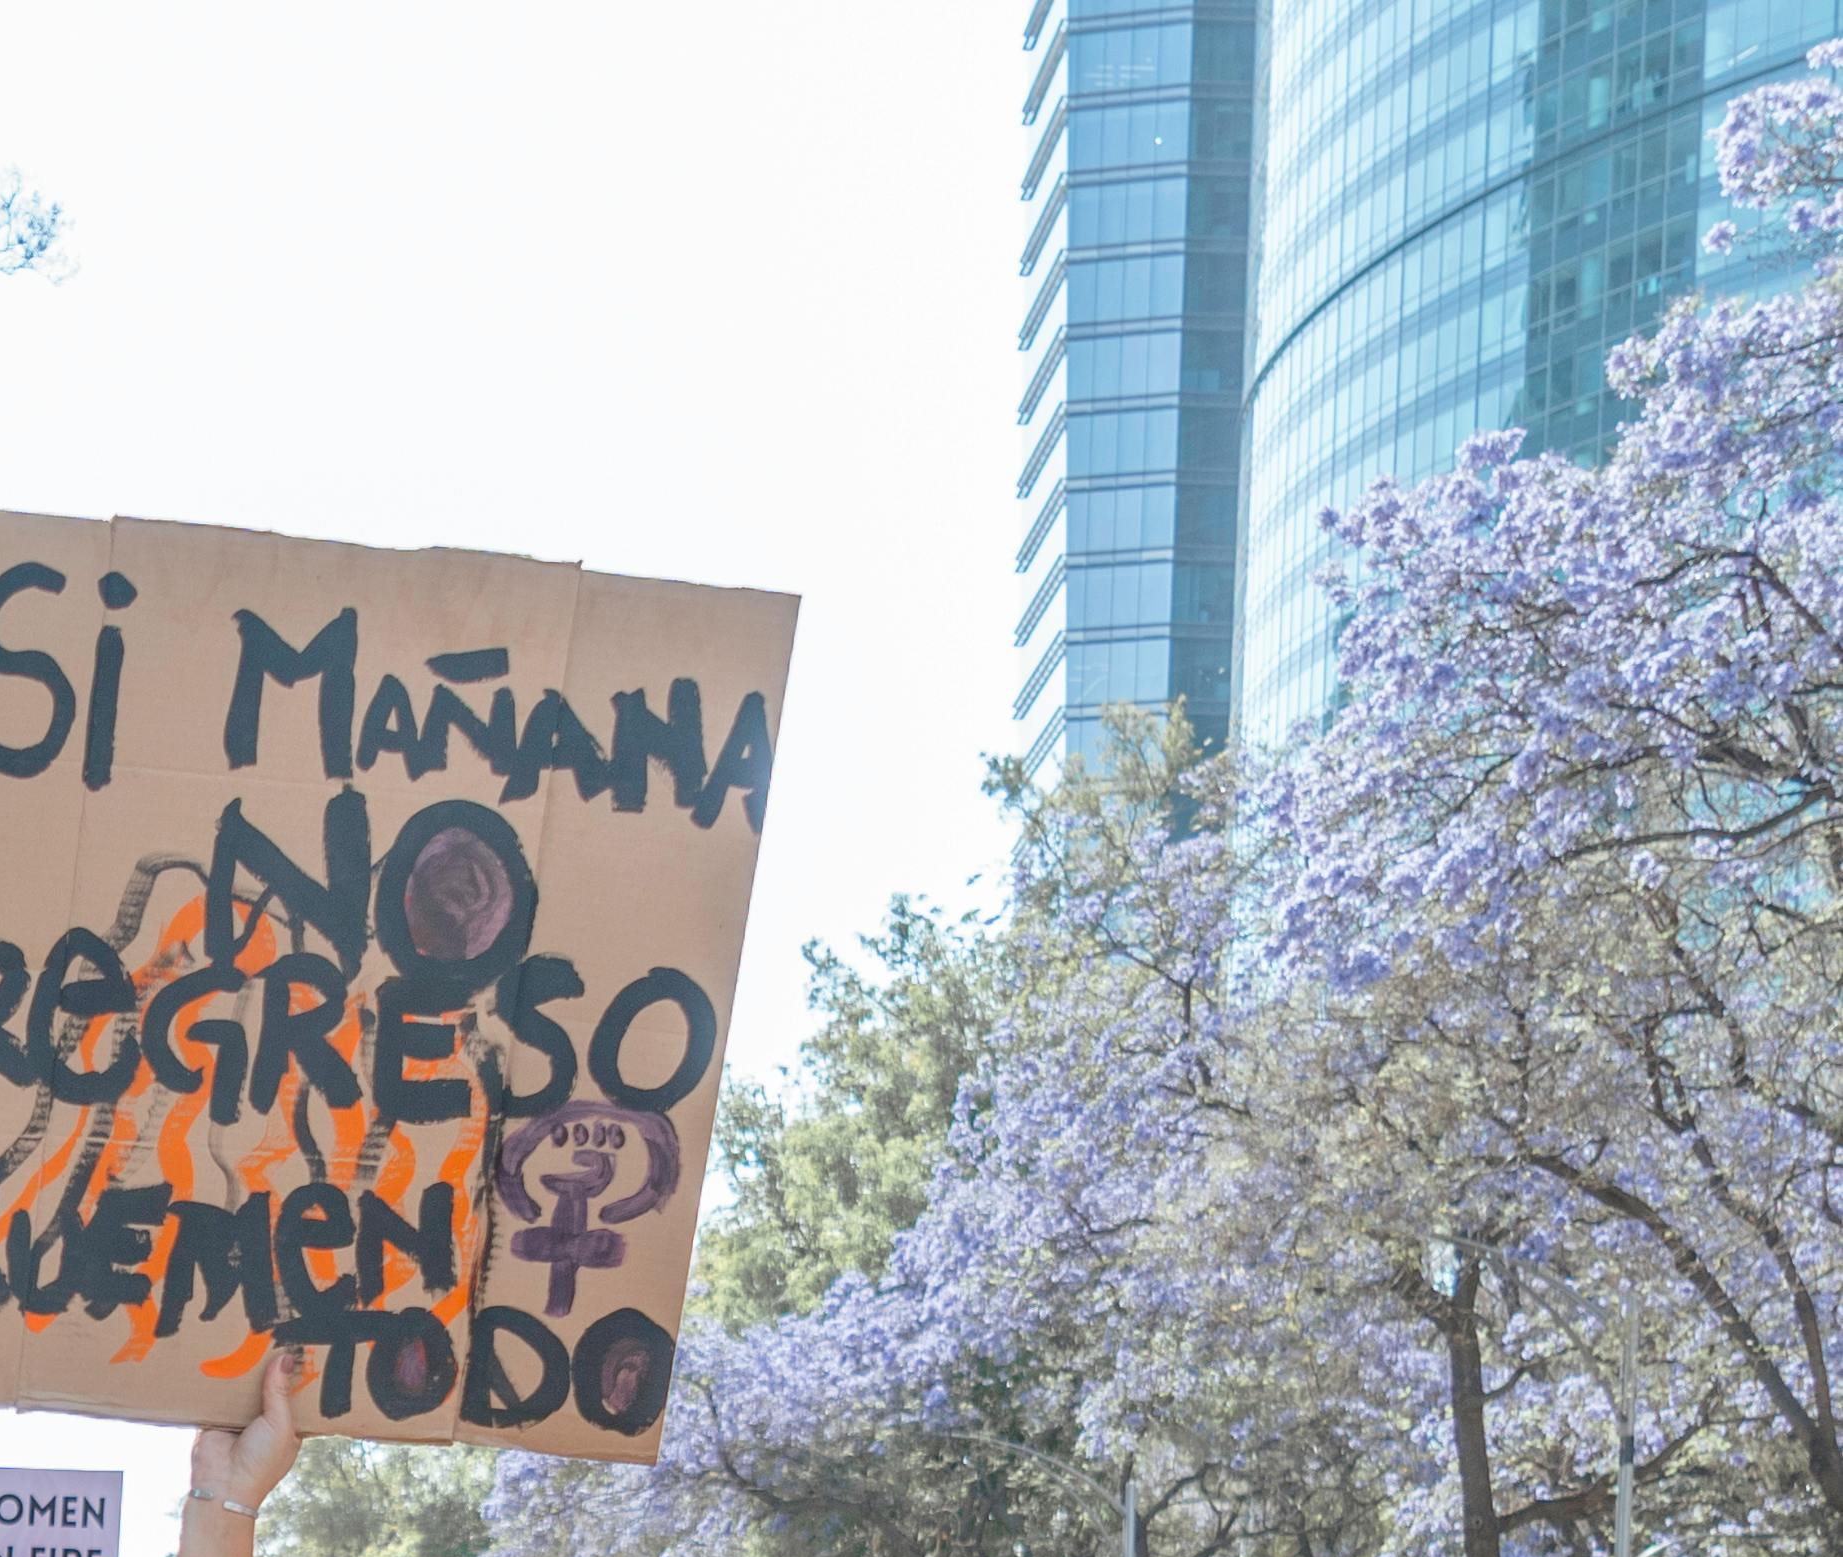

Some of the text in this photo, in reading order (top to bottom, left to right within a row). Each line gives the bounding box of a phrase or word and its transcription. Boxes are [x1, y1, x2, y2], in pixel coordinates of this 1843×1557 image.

[223, 606, 774, 831] MAÑANA
[204, 784, 540, 990] NO
[274, 1307, 676, 1436] TODO
